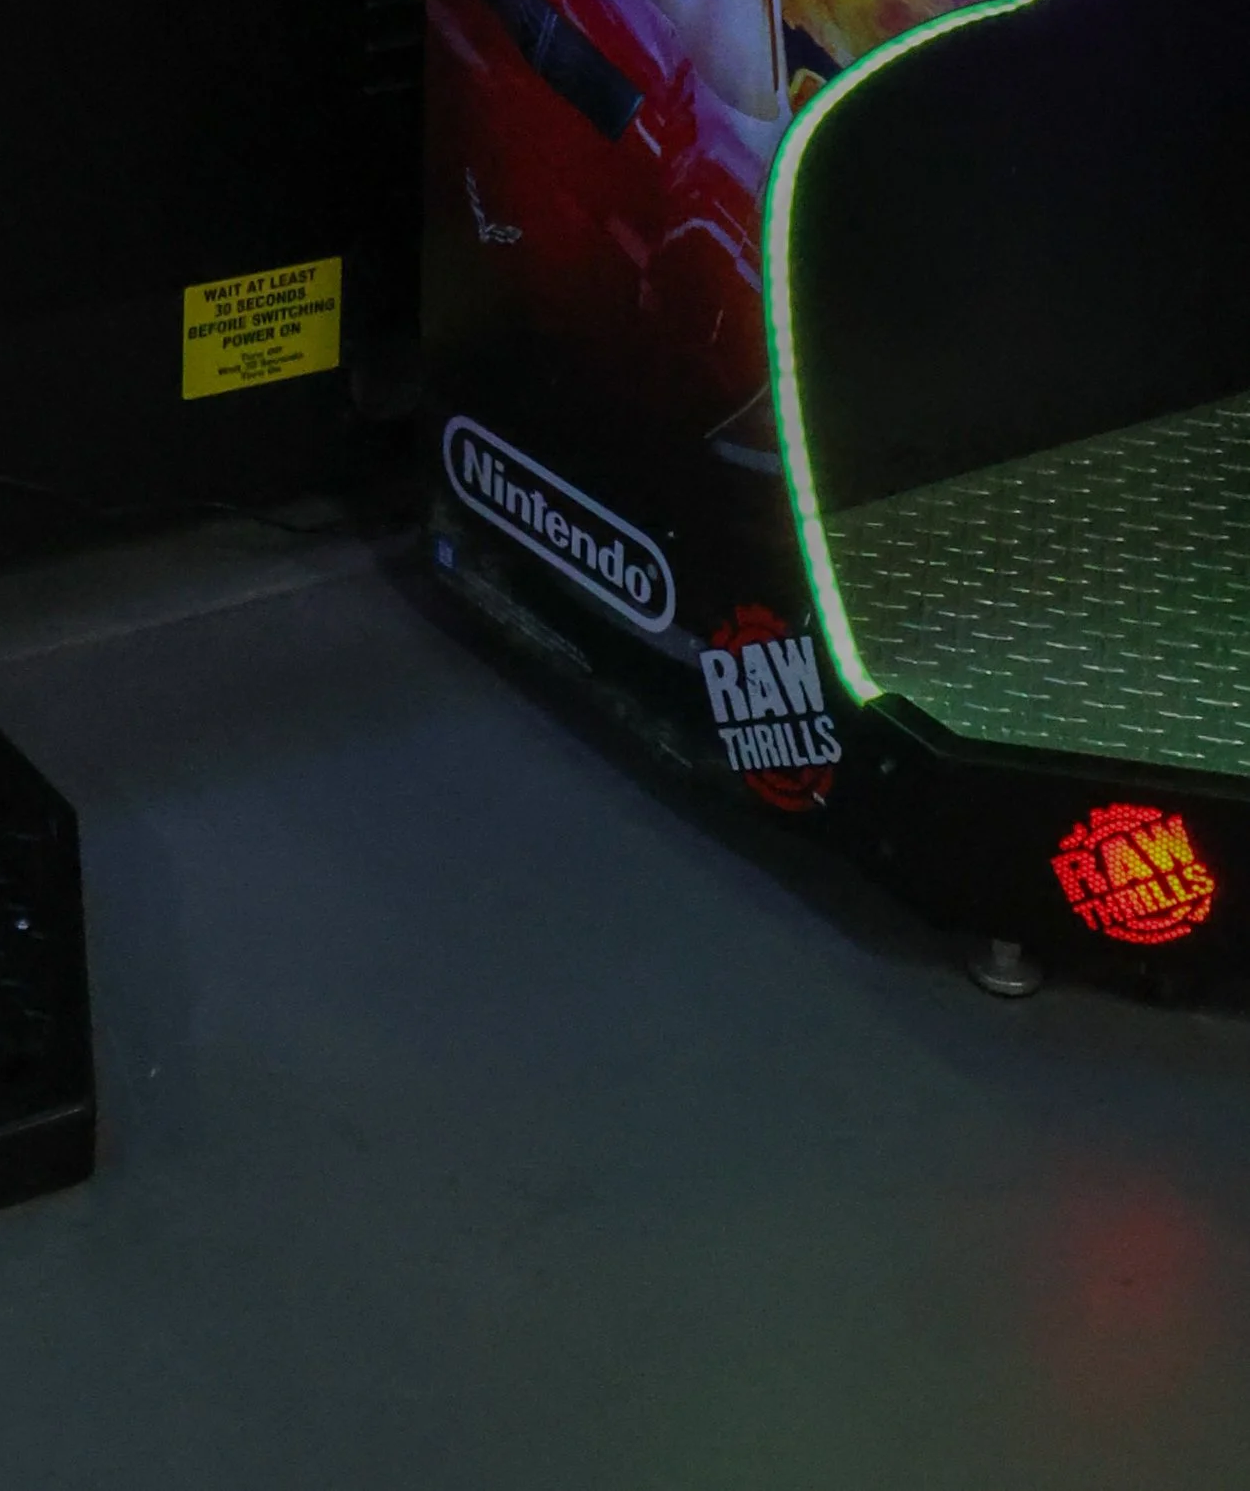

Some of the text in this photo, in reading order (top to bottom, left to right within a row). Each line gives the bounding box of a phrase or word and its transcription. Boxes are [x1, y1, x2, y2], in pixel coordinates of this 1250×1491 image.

[204, 267, 317, 302] WAIT AT LEAST
[215, 287, 306, 317] 30 SECONDS
[188, 298, 335, 339] BEFORE SWITCHING
[222, 321, 300, 349] POWER ON
[462, 439, 654, 605] Nintendo
[700, 635, 826, 725] RAW
[718, 713, 843, 773] THRILLS
[1051, 814, 1194, 903] RAW
[1072, 863, 1215, 931] THRILLS
